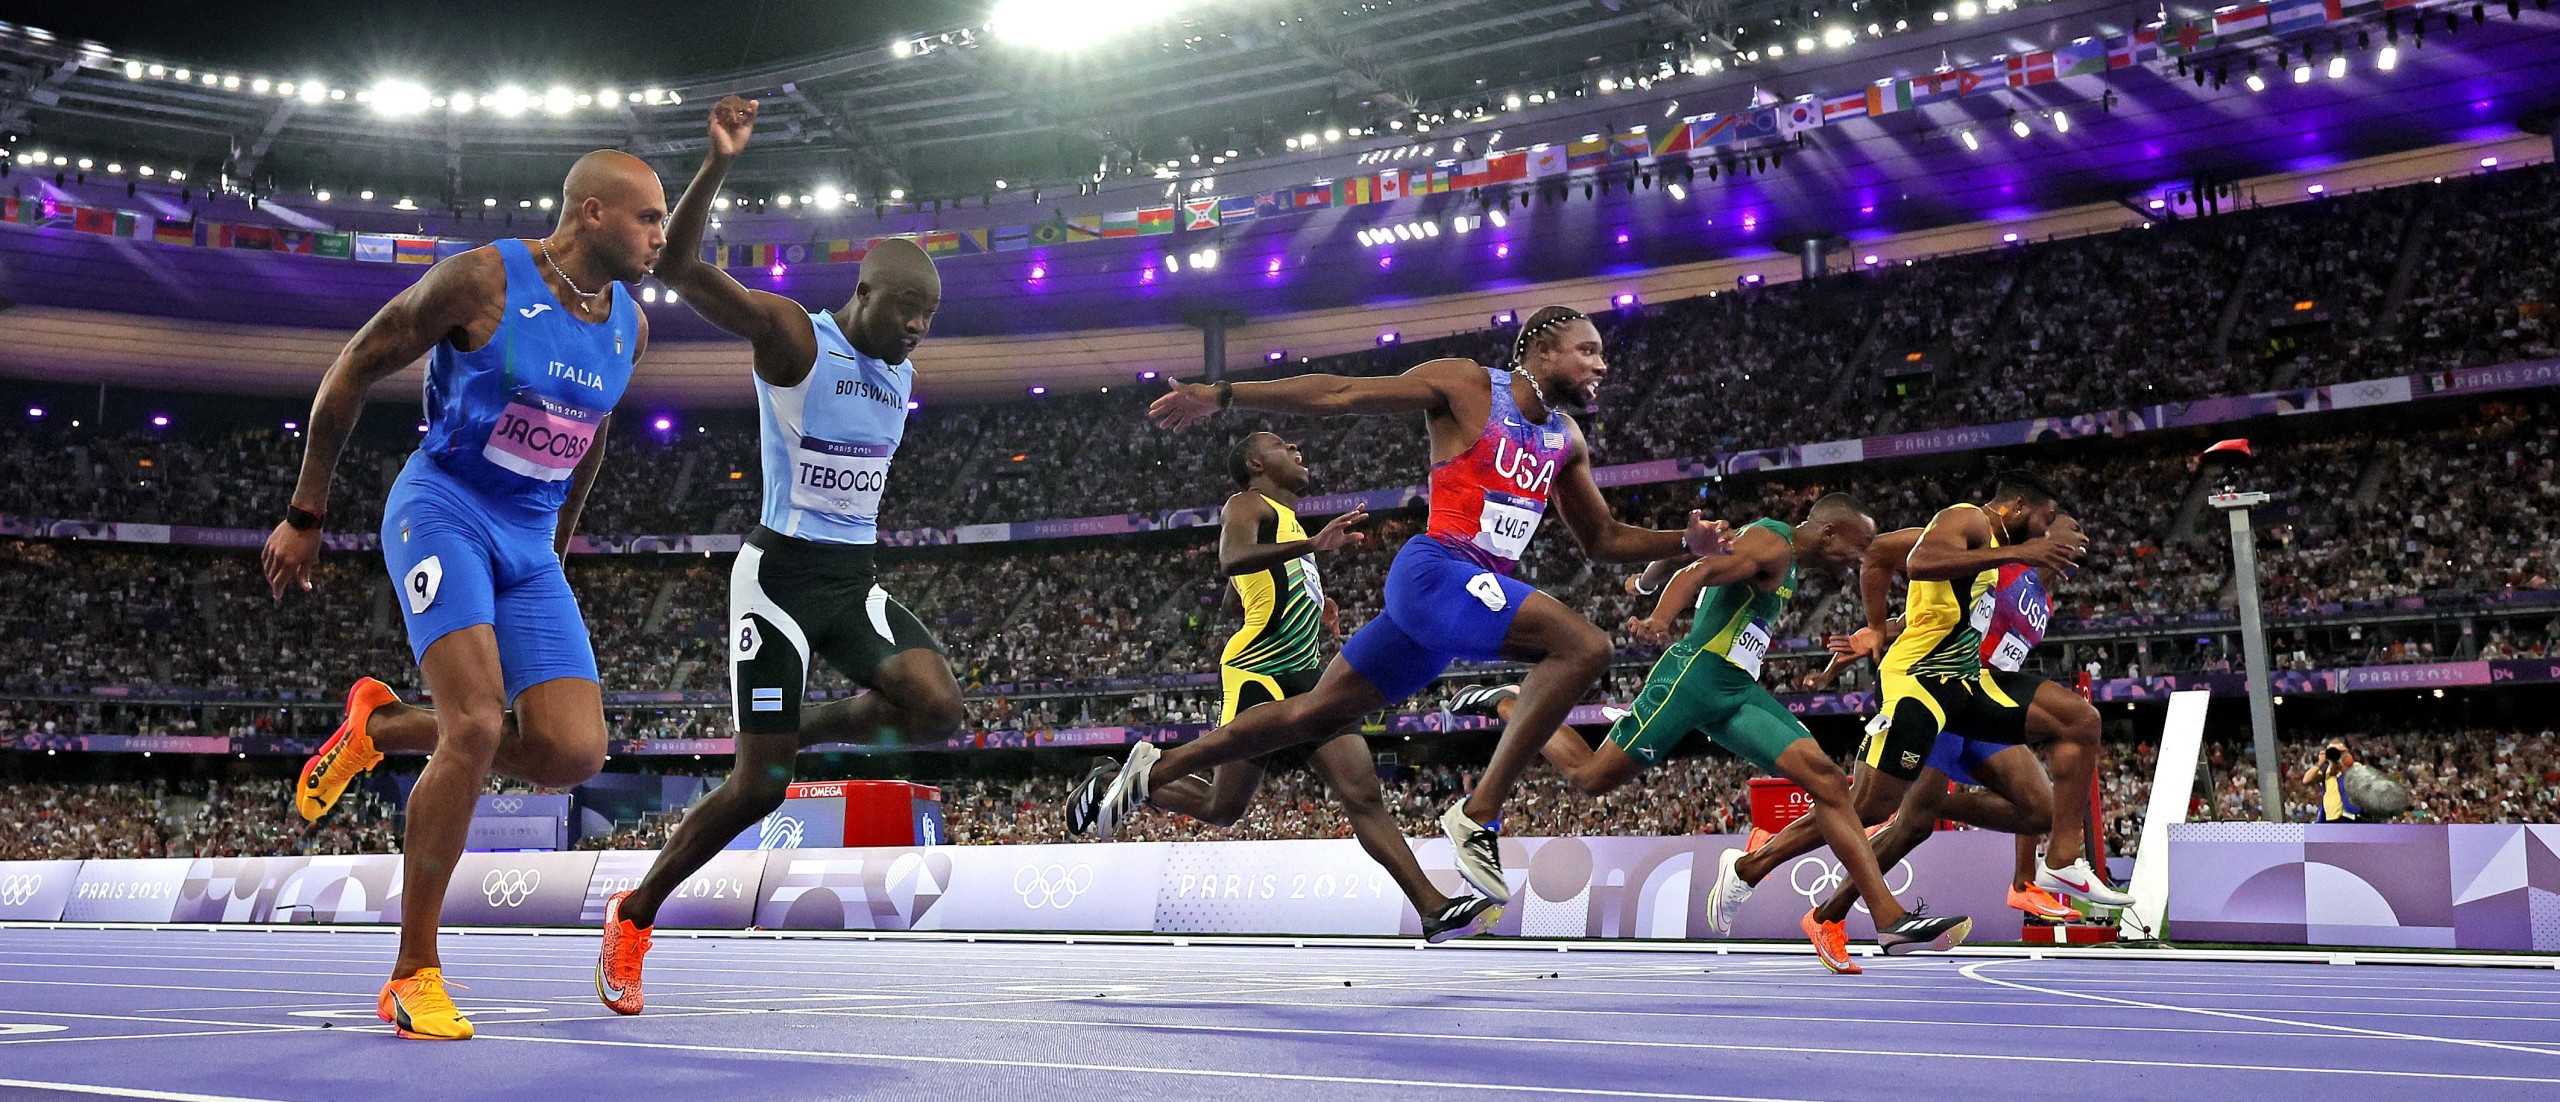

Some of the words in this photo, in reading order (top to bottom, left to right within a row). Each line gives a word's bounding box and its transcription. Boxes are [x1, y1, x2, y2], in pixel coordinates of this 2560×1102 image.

[548, 361, 604, 391] ITALIA
[836, 380, 903, 412] BOTSWANA
[497, 414, 588, 459] JACOBS
[1895, 436, 1941, 451] PARIS
[1947, 431, 1990, 446] 2024
[828, 444, 851, 453] PARIS
[1495, 437, 1555, 496] USA
[800, 462, 882, 492] TEBOGO
[1594, 470, 1617, 483] RIS
[1297, 501, 1332, 512] PARIS
[242, 532, 267, 543] 202
[1034, 523, 1069, 535] PARIS
[414, 571, 429, 599] 9
[2018, 588, 2047, 638] USA
[739, 626, 753, 652] 8
[2359, 670, 2409, 683] PARIS
[2416, 668, 2463, 681] 2024
[125, 738, 158, 749] PARIS
[1053, 733, 1082, 742] PARIS
[655, 743, 685, 752] PARIS
[810, 785, 843, 798] OMEGA
[128, 881, 172, 900] 2024
[676, 877, 743, 899] 2024
[1289, 873, 1383, 899] 2024
